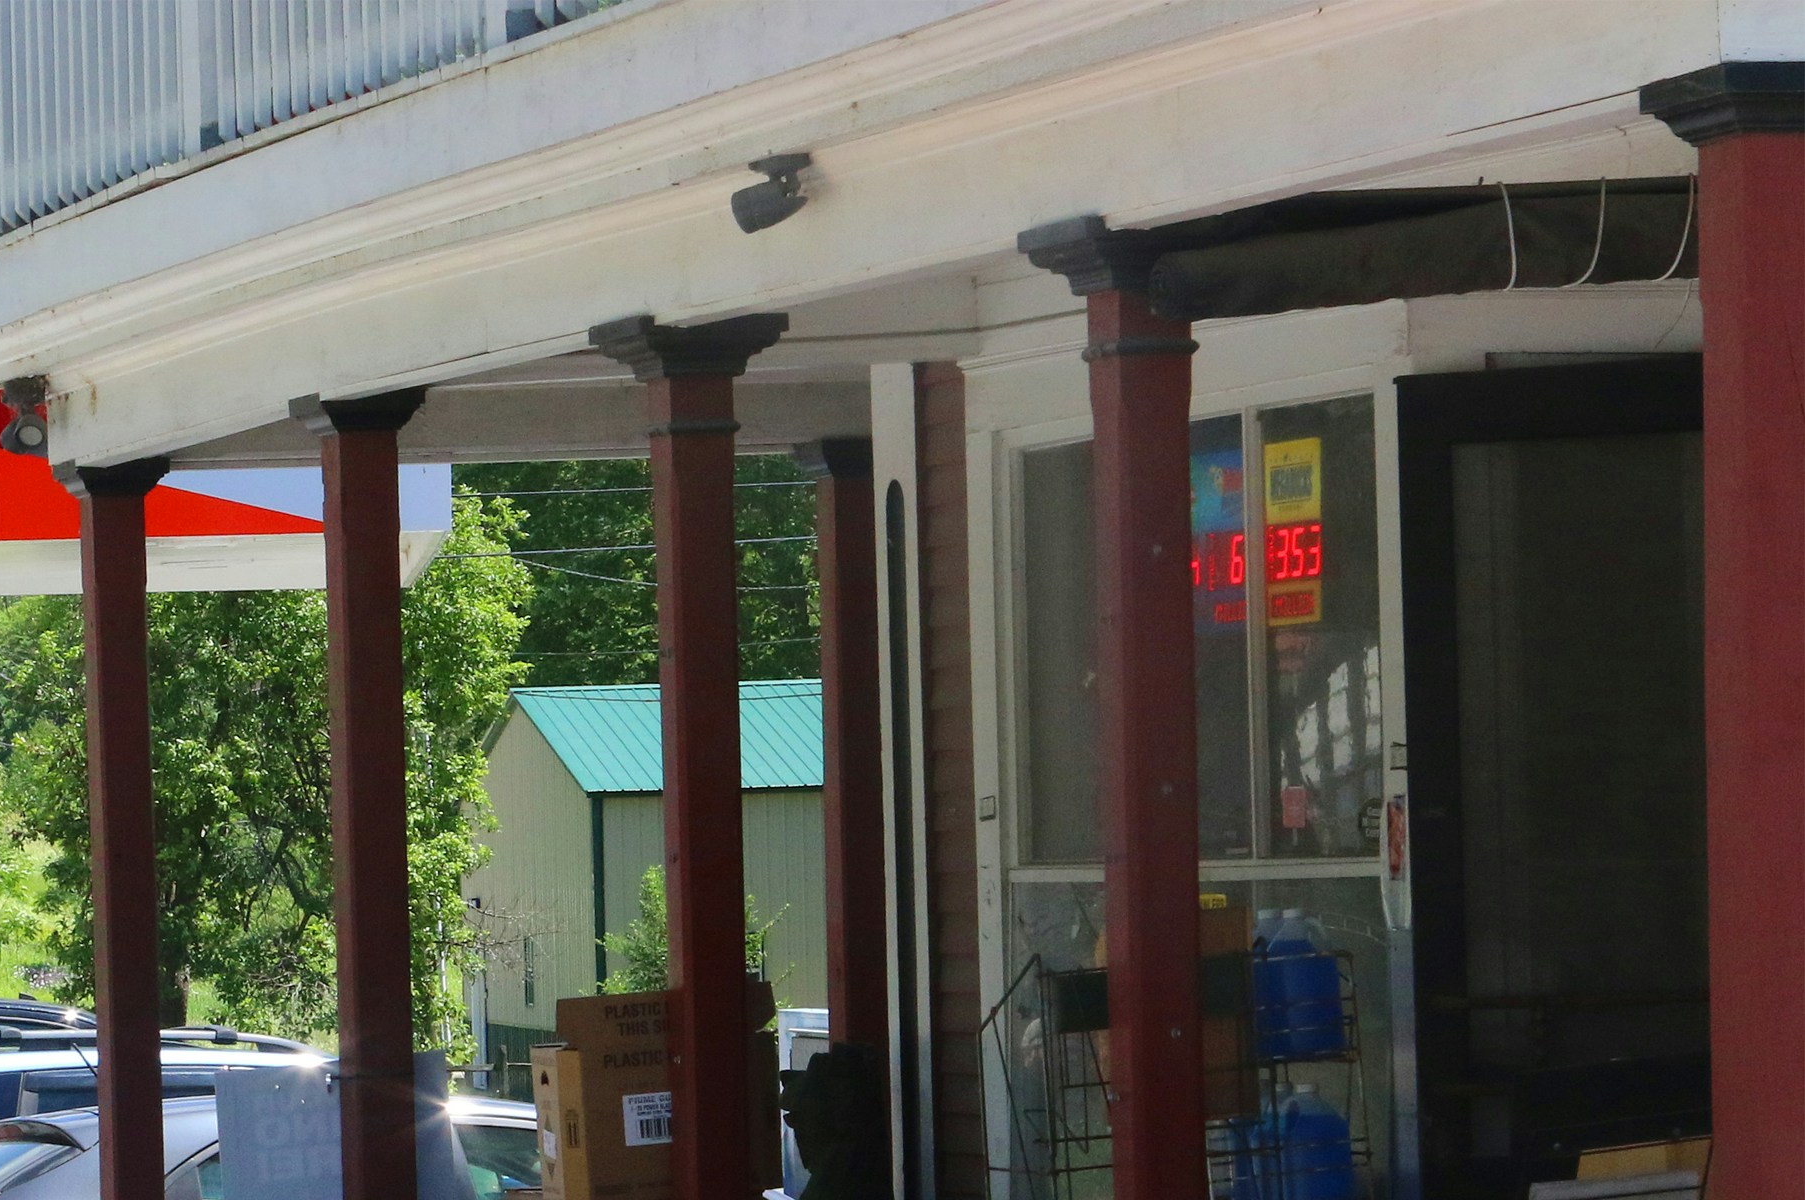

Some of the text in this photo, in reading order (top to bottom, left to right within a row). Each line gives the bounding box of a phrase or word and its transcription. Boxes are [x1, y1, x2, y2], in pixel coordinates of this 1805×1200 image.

[605, 1002, 661, 1019] PLASTIC
[618, 1020, 649, 1036] THIS
[604, 1050, 662, 1069] PLASTIC
